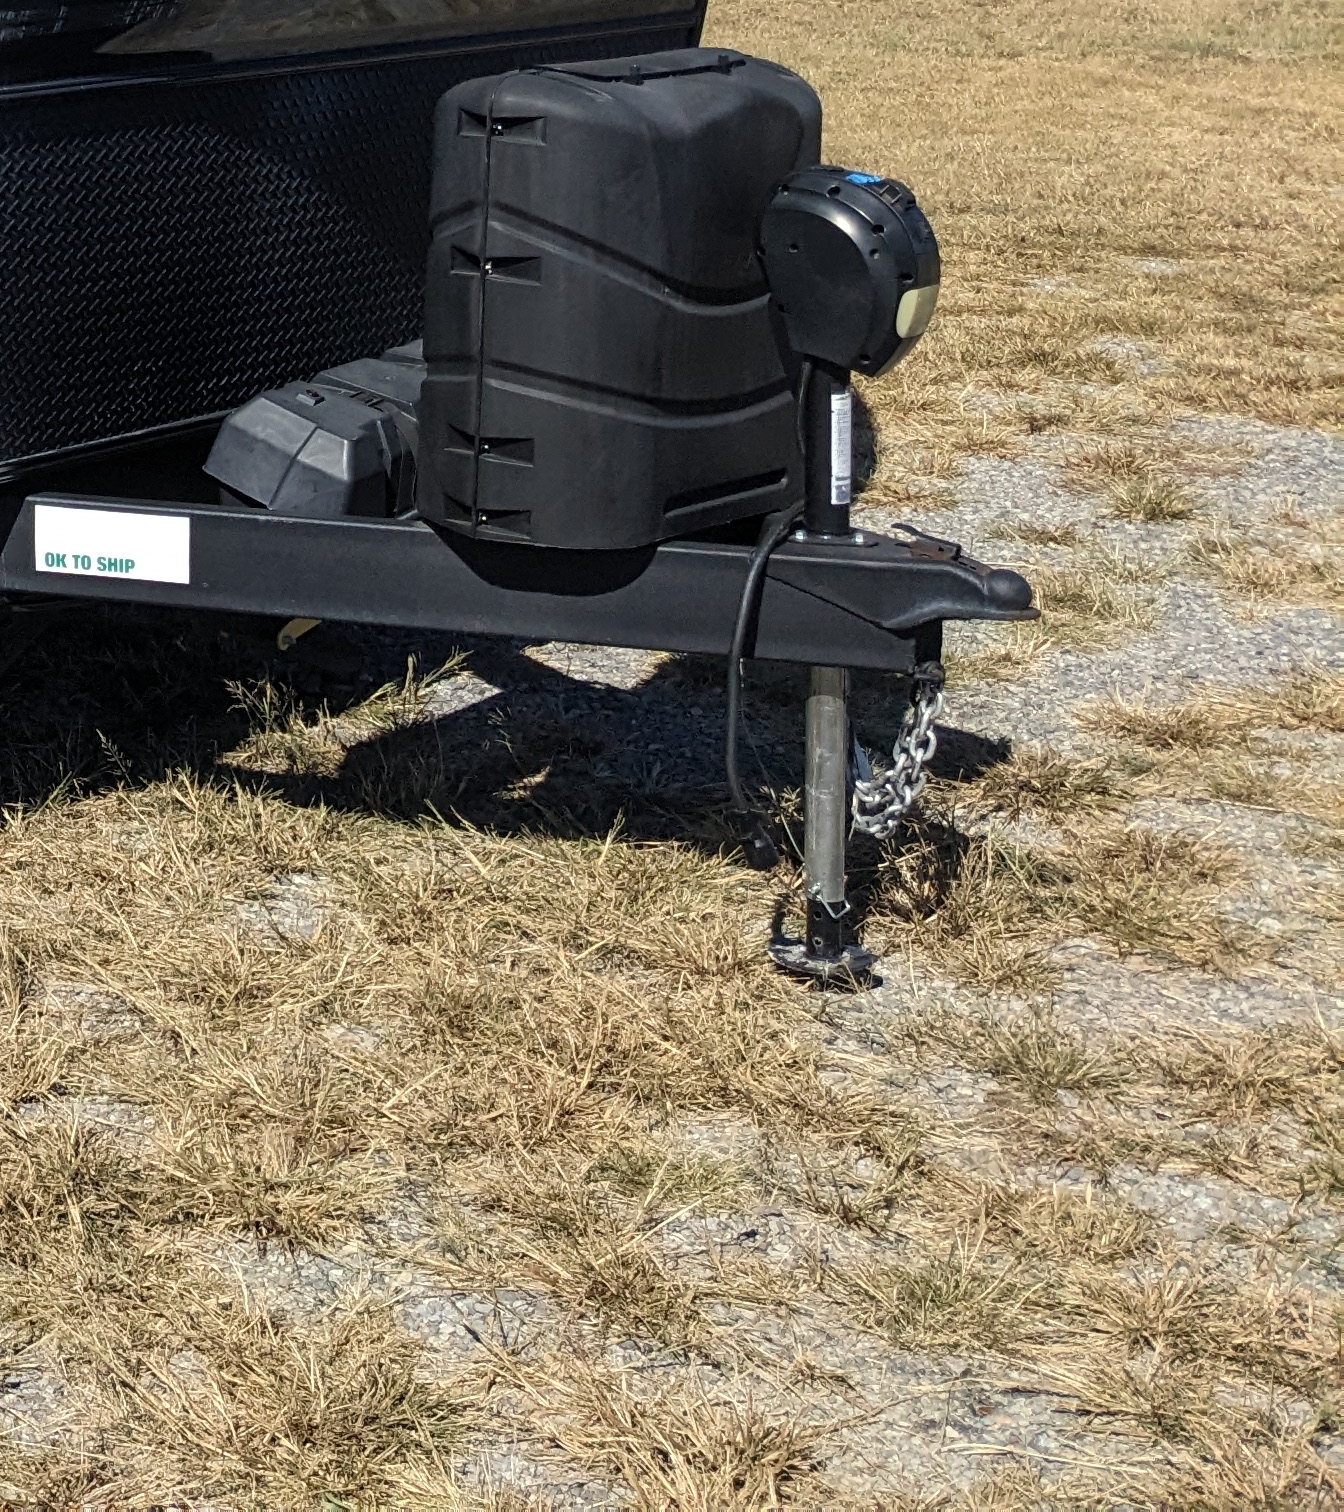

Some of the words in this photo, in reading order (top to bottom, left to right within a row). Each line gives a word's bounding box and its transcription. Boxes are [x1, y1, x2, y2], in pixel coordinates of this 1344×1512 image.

[44, 551, 67, 569] OK
[72, 554, 92, 571] TO
[97, 556, 136, 574] SHIP
